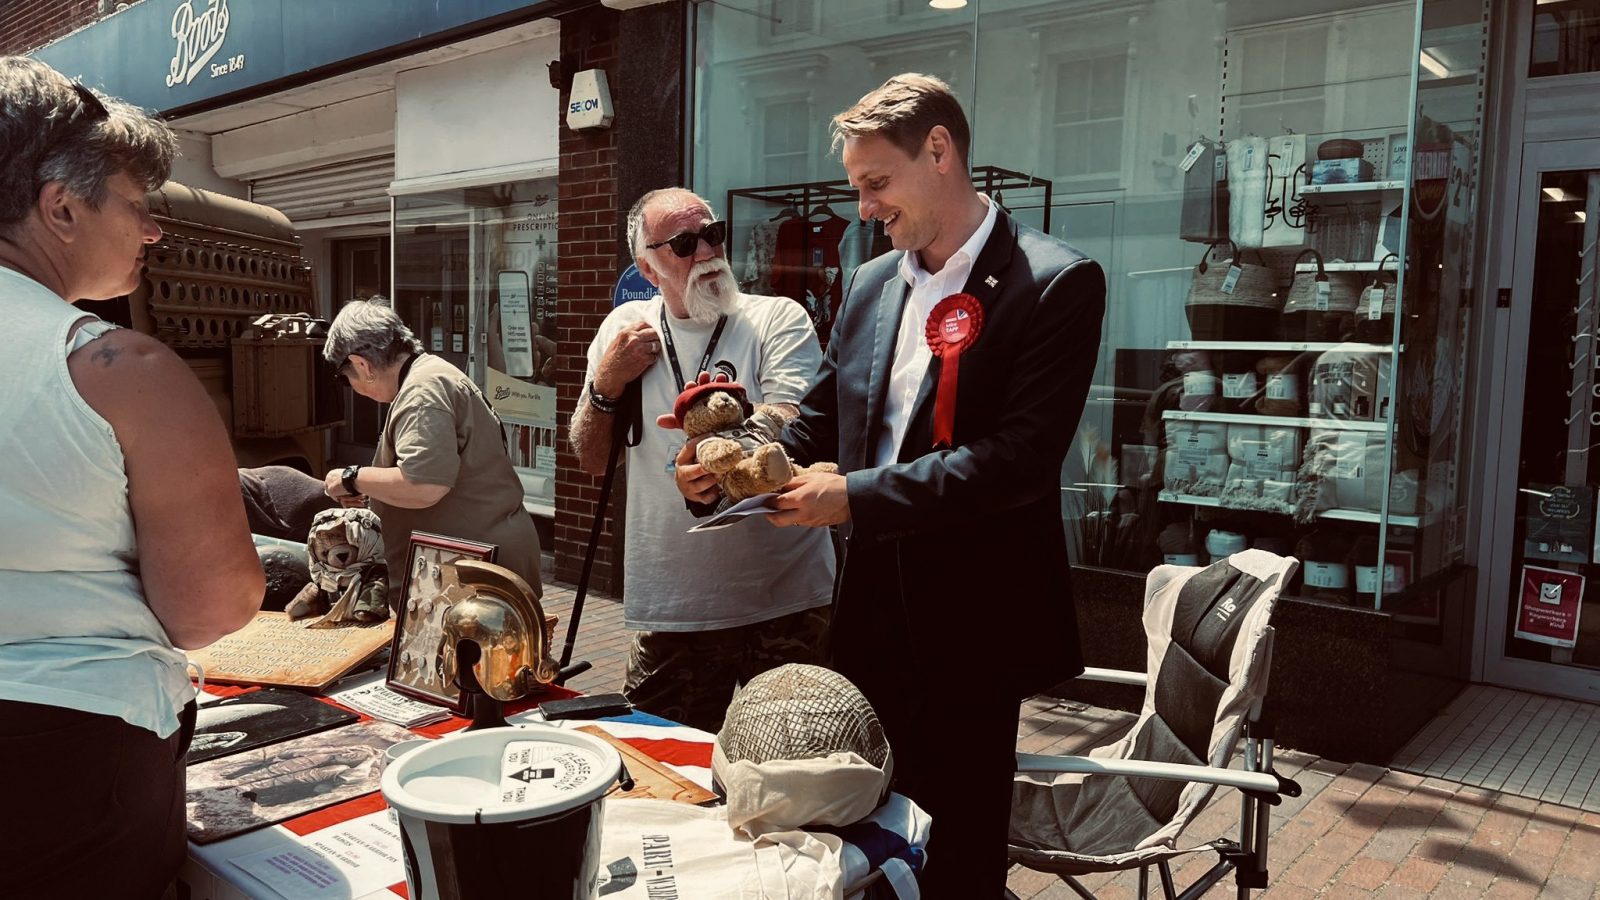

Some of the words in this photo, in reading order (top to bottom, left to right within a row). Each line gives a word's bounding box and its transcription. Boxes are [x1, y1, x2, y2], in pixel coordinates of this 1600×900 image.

[166, 0, 230, 88] Boots
[210, 63, 228, 78] Since
[228, 54, 244, 73] 1849
[570, 98, 598, 114] SECOM
[509, 752, 518, 762] YOU
[520, 749, 530, 764] THANK
[563, 752, 591, 774] PLEASE
[560, 776, 587, 790] GIVE
